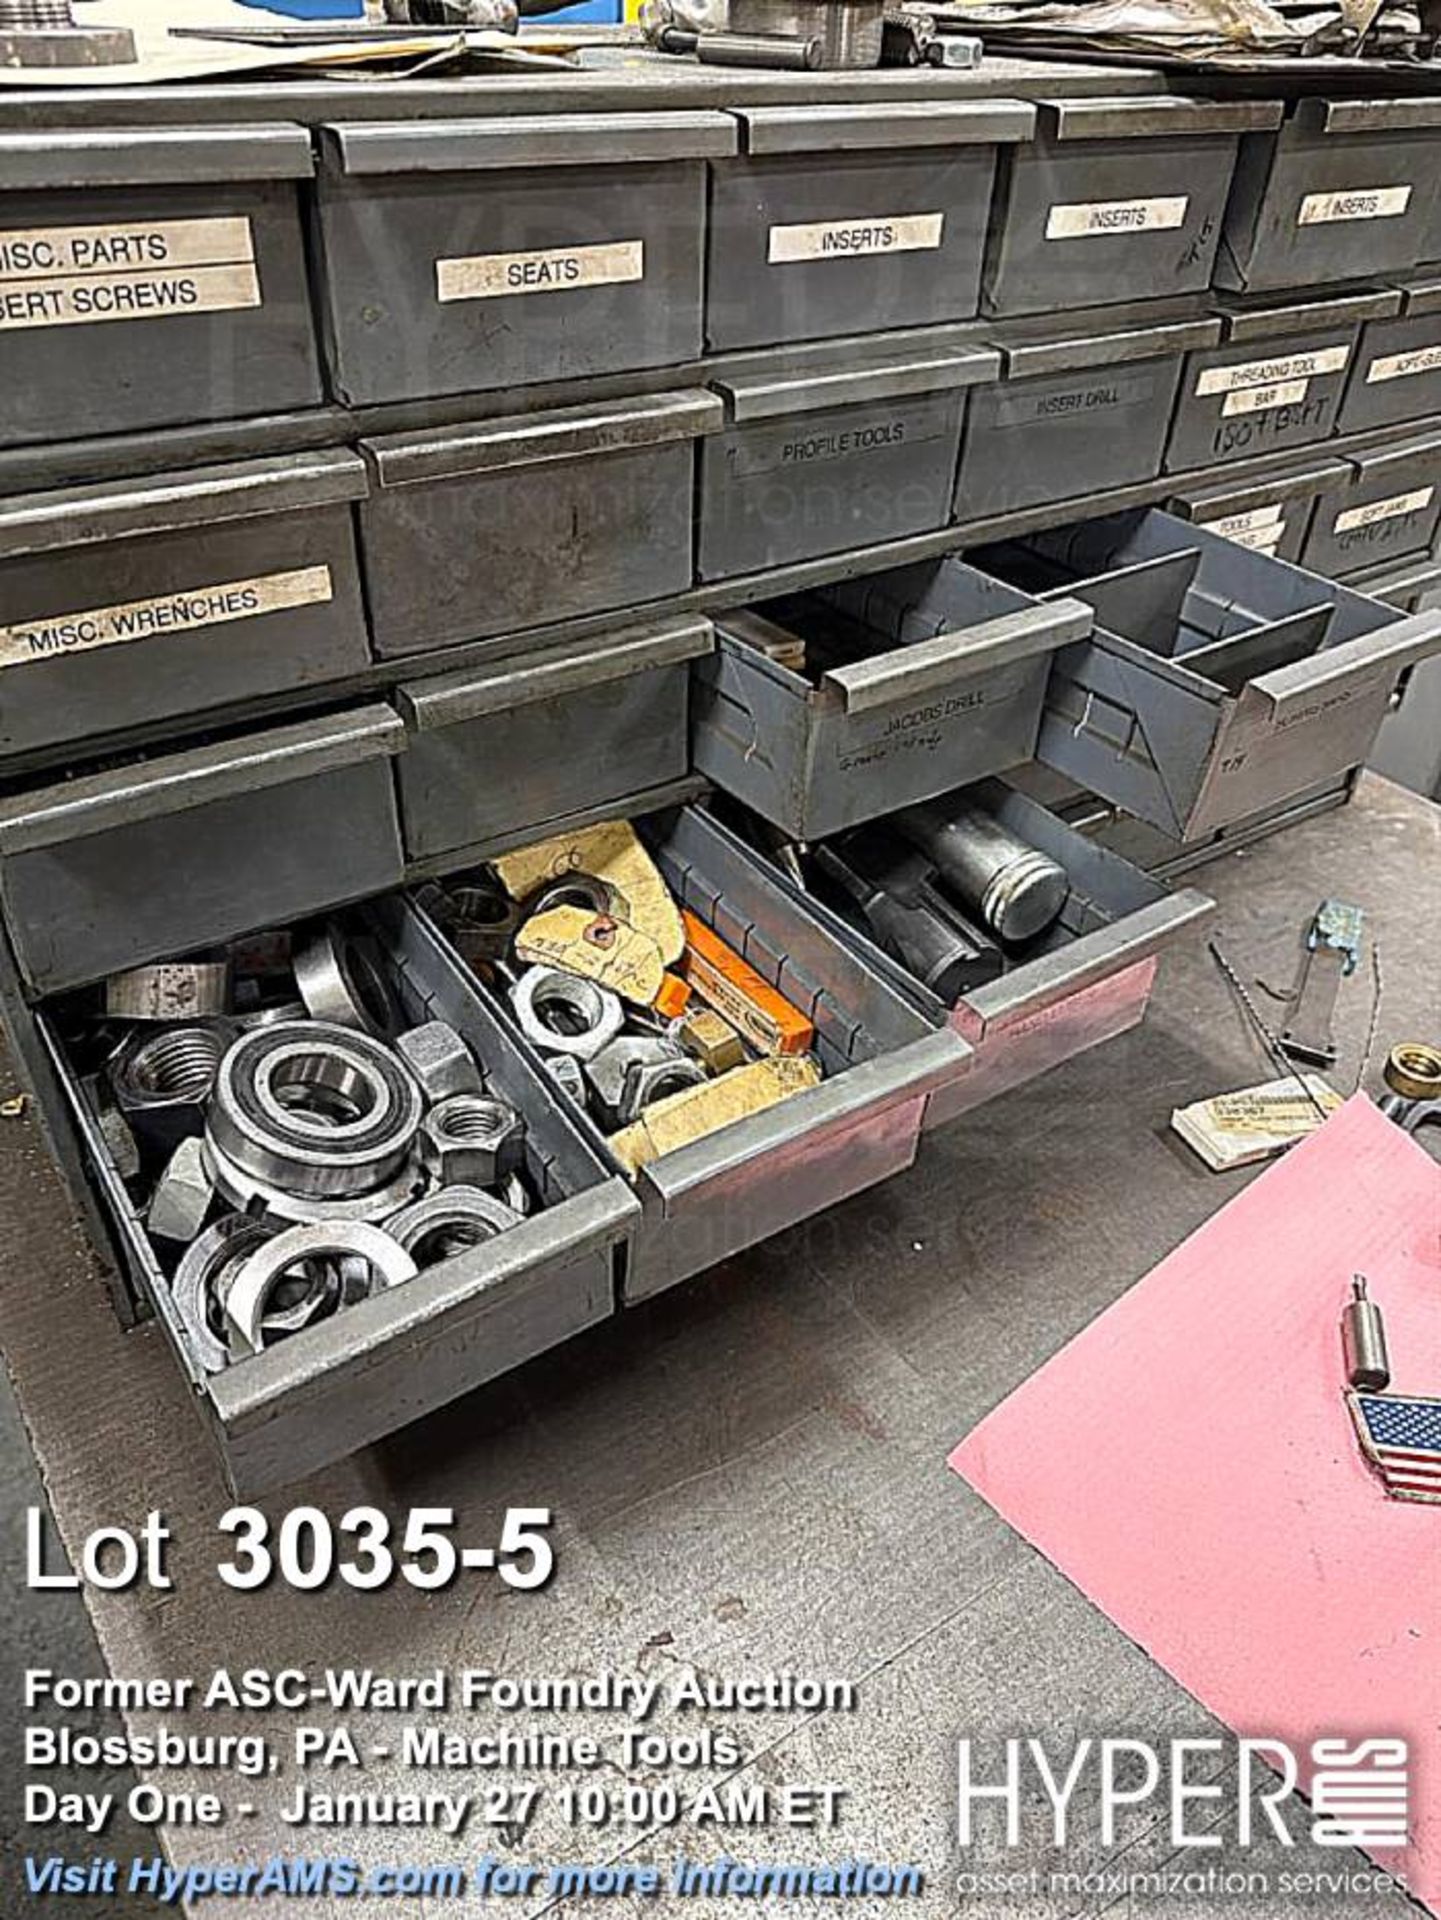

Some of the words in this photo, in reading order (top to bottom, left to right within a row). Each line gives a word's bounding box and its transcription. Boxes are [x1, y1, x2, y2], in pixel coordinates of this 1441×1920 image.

[1089, 206, 1148, 229] INSERTS
[0, 241, 64, 271] ISC.
[72, 234, 168, 267] PARTS
[821, 226, 893, 252] INSERTS
[507, 258, 579, 286] SEATS
[0, 290, 62, 320] ERT
[72, 279, 197, 315] SCREWS
[782, 430, 850, 462] PROFILE
[853, 422, 904, 448] TOOLS
[28, 619, 105, 654] MISC.
[111, 588, 259, 635] WRENCHES
